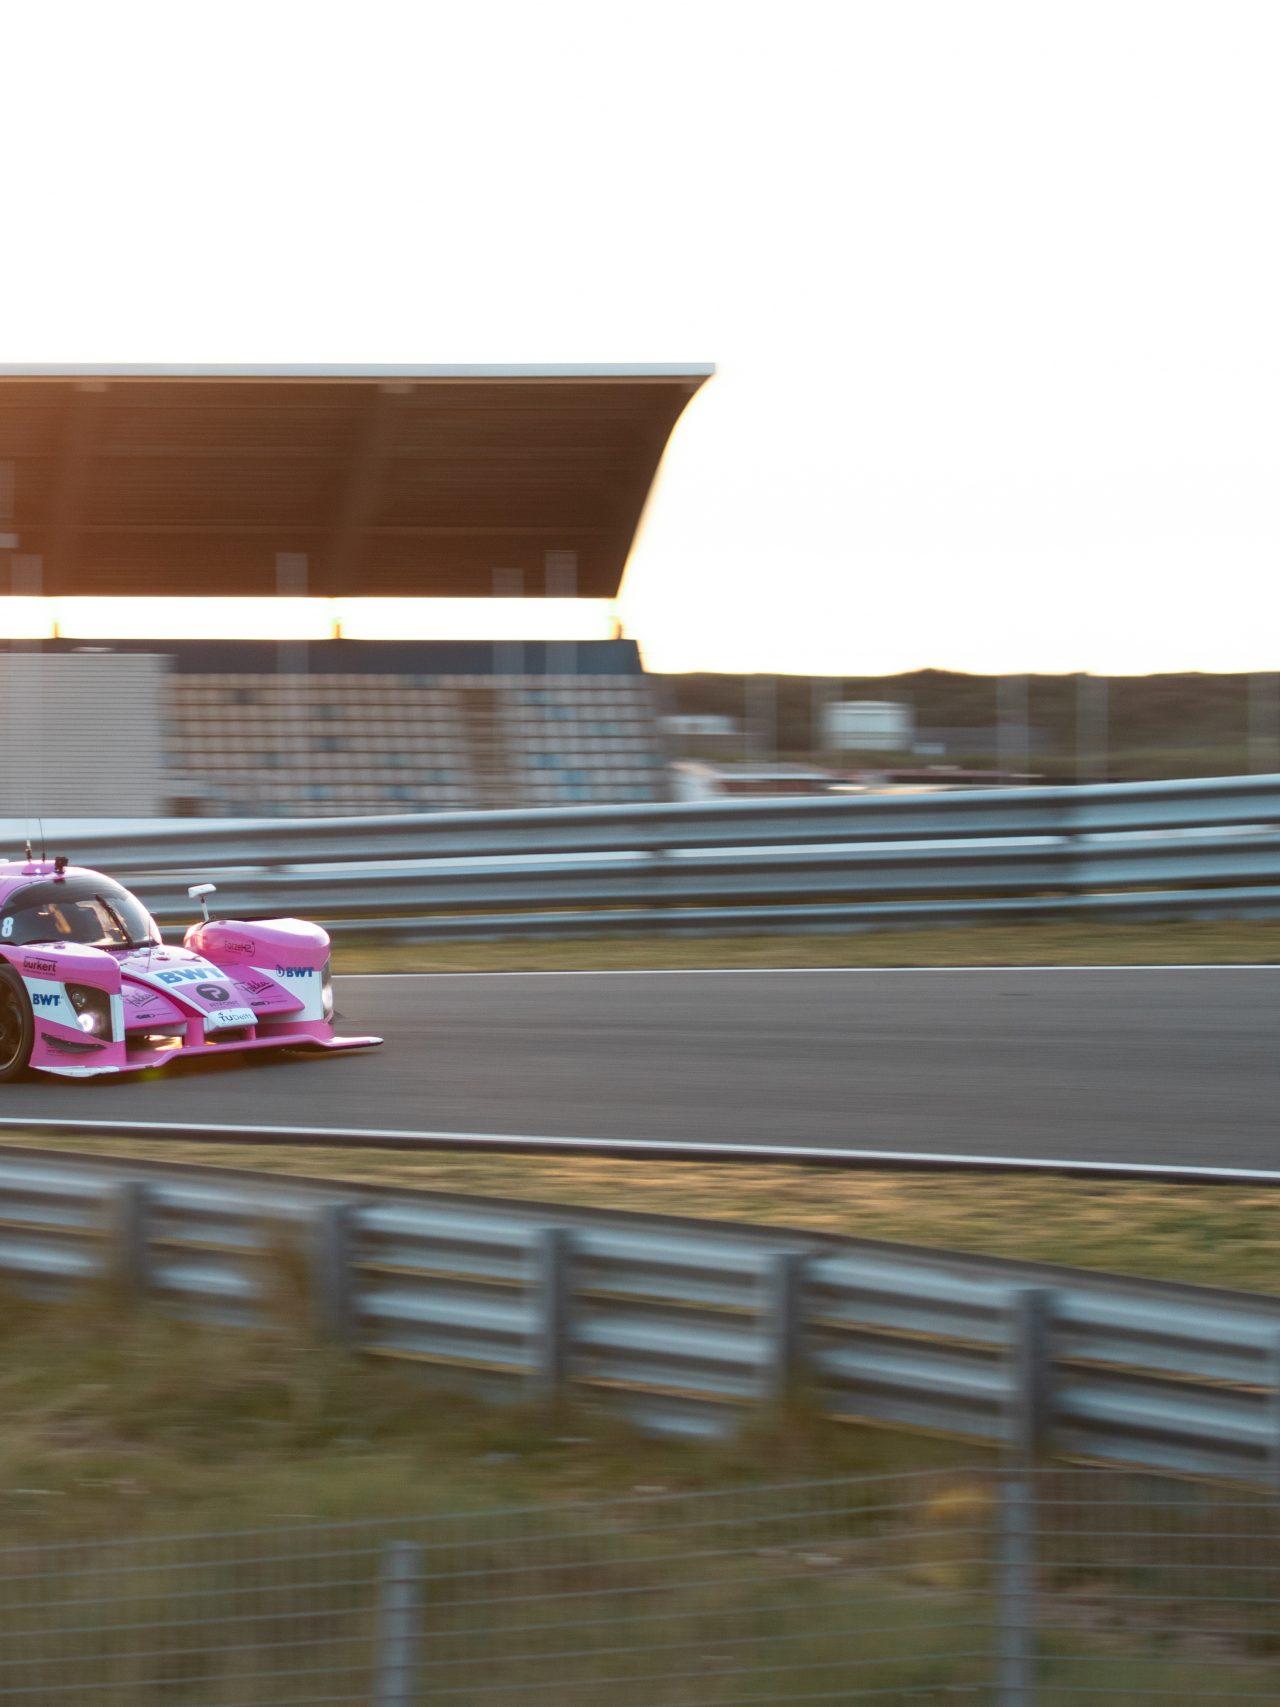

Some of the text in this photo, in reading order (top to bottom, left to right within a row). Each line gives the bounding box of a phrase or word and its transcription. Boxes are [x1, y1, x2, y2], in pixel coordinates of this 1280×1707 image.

[2, 916, 14, 937] 8
[155, 967, 224, 984] BWT
[286, 967, 314, 977] BWT
[33, 993, 60, 1006] BWT
